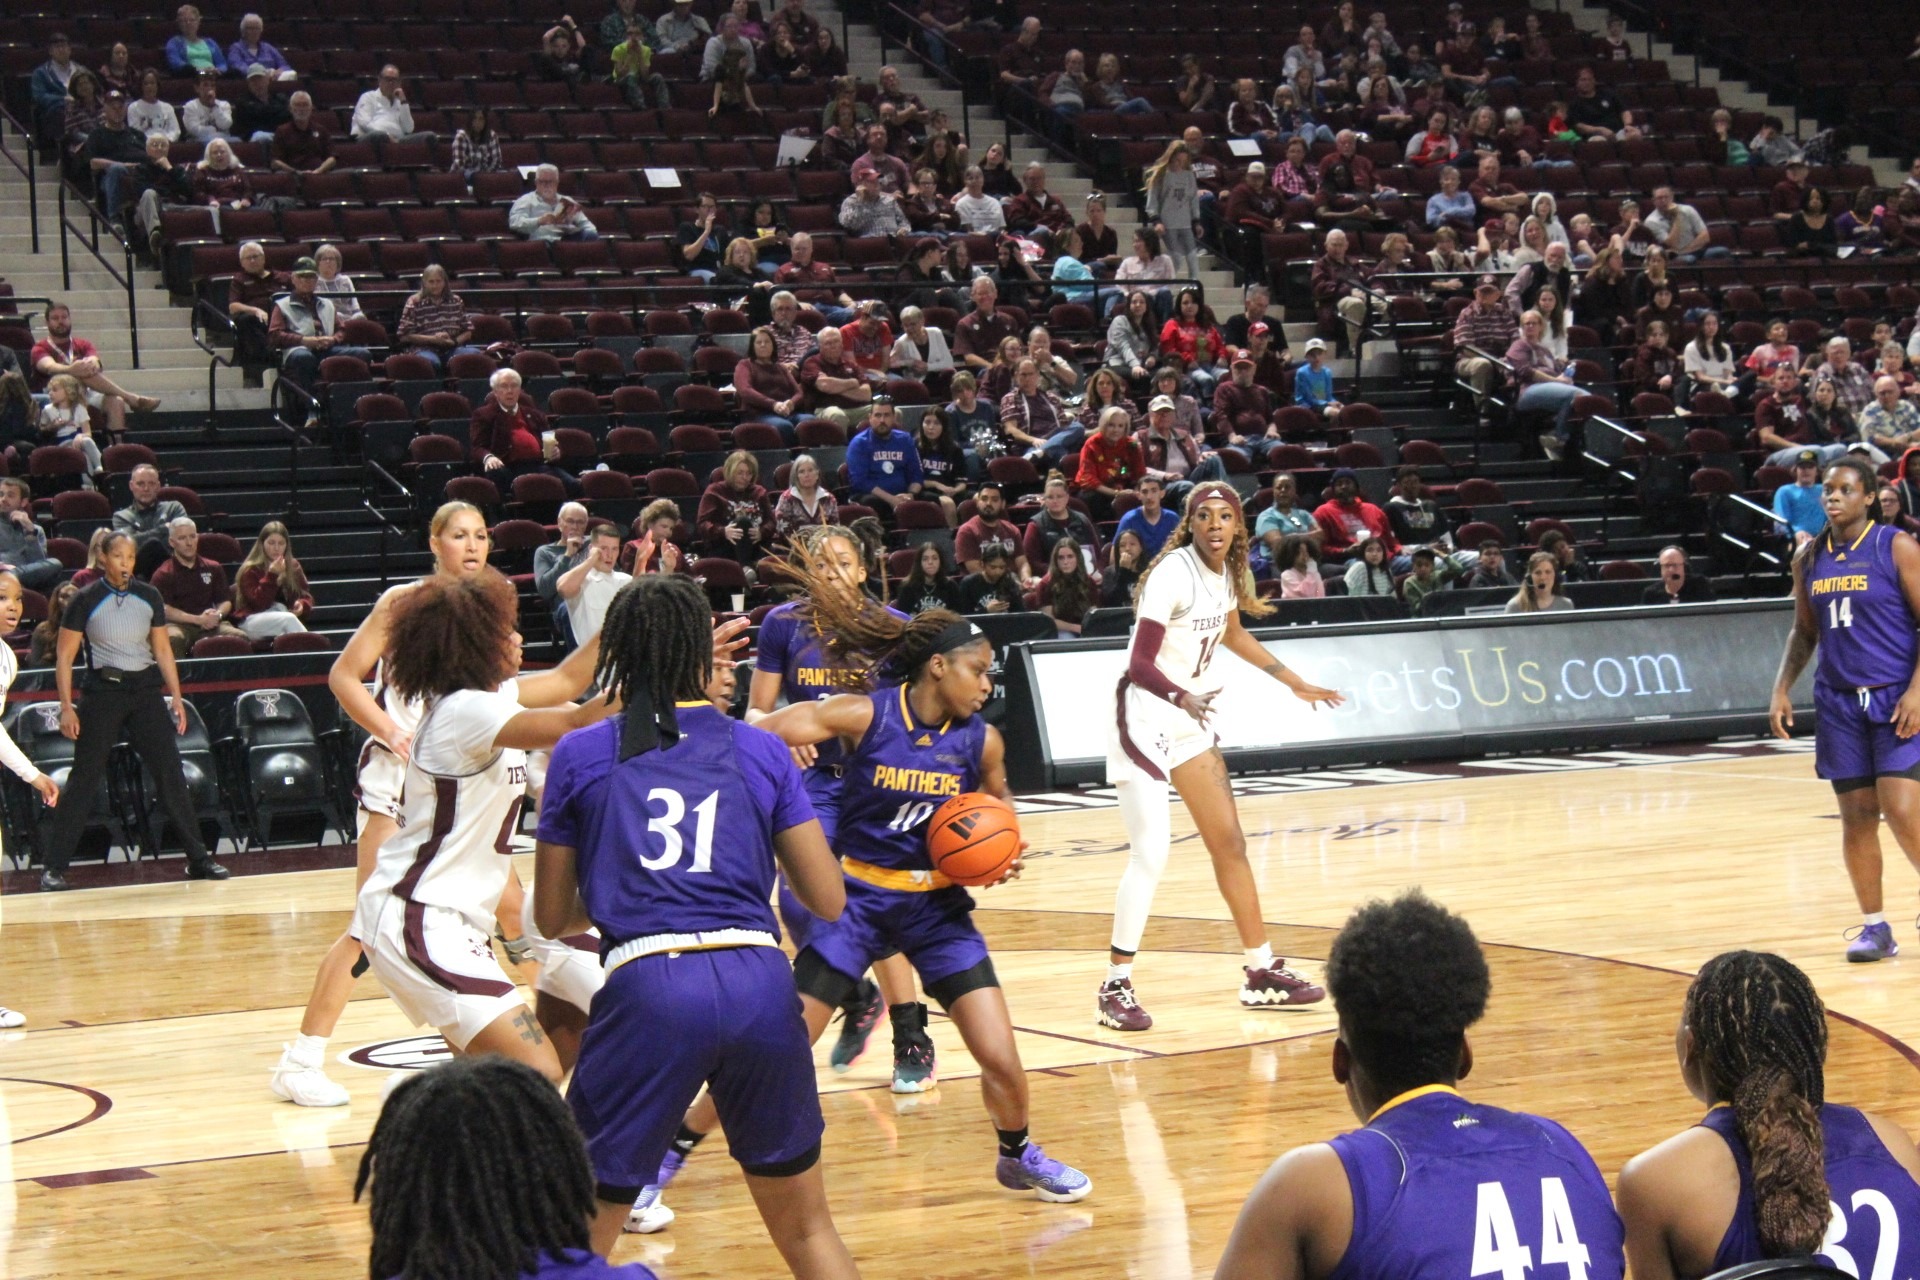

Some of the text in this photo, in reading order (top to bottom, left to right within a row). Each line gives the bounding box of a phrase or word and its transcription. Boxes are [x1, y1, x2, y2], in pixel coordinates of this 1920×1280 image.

[1812, 575, 1868, 597] PANTHERS
[1192, 615, 1222, 631] TEXAS
[1828, 597, 1853, 629] 14
[1191, 631, 1222, 678] 14
[797, 667, 868, 687] PANT
[873, 764, 962, 796] PANTHERS
[640, 788, 719, 873] 31
[886, 800, 934, 832] 10
[1470, 1177, 1592, 1280] 44
